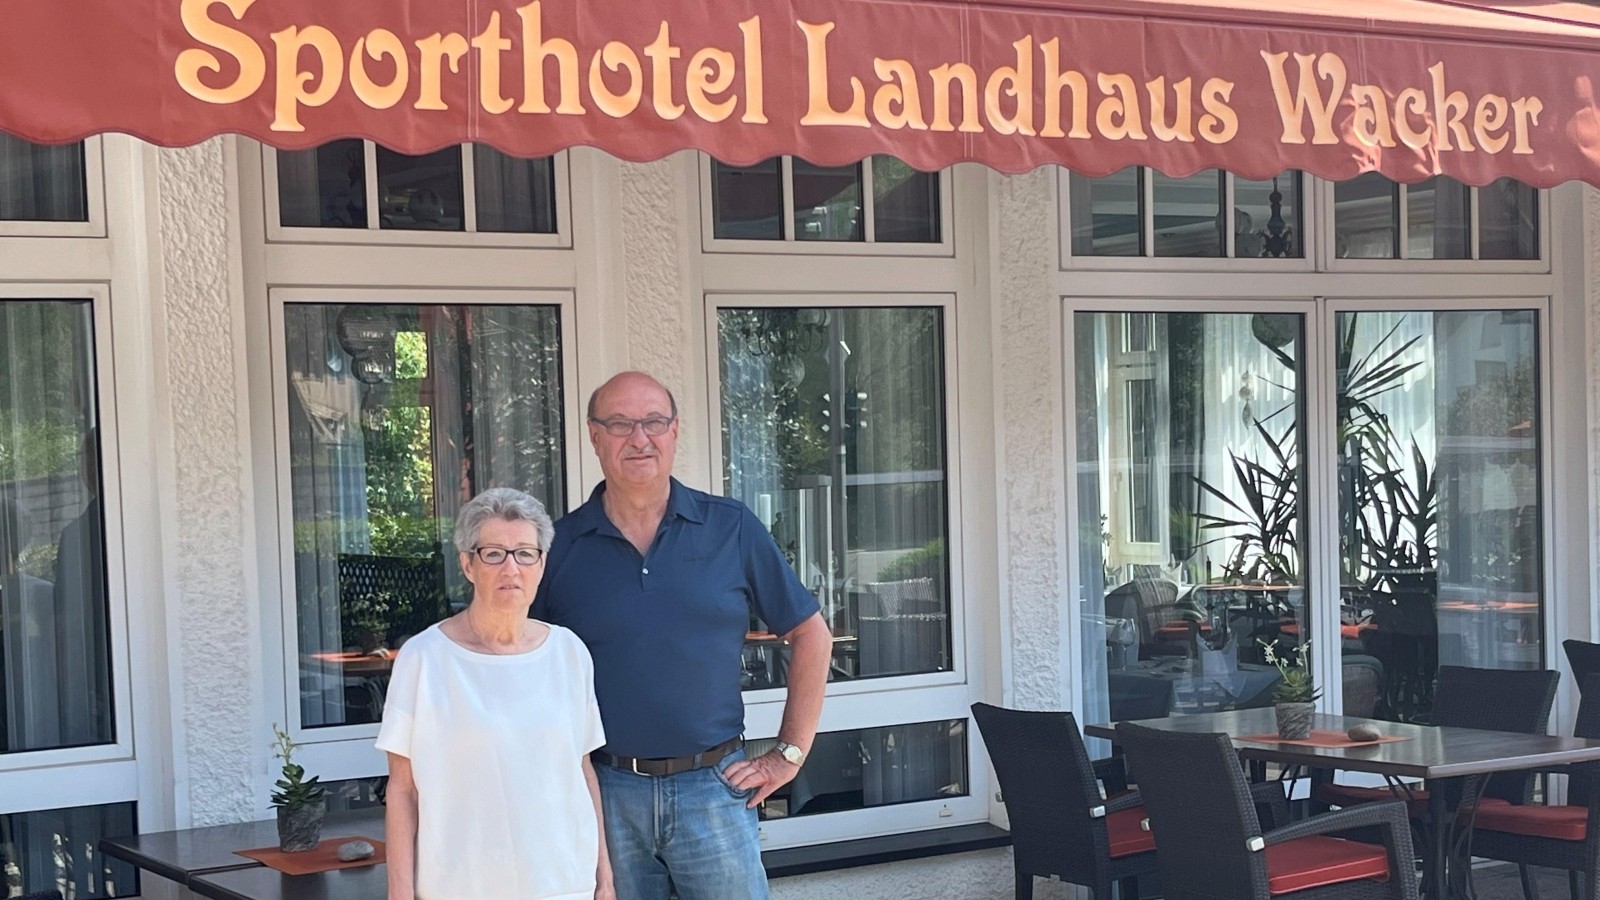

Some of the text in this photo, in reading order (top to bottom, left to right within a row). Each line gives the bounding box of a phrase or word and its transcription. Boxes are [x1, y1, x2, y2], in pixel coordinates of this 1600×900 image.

[174, 0, 1544, 155] Sporthotel Landhaus Wacker
